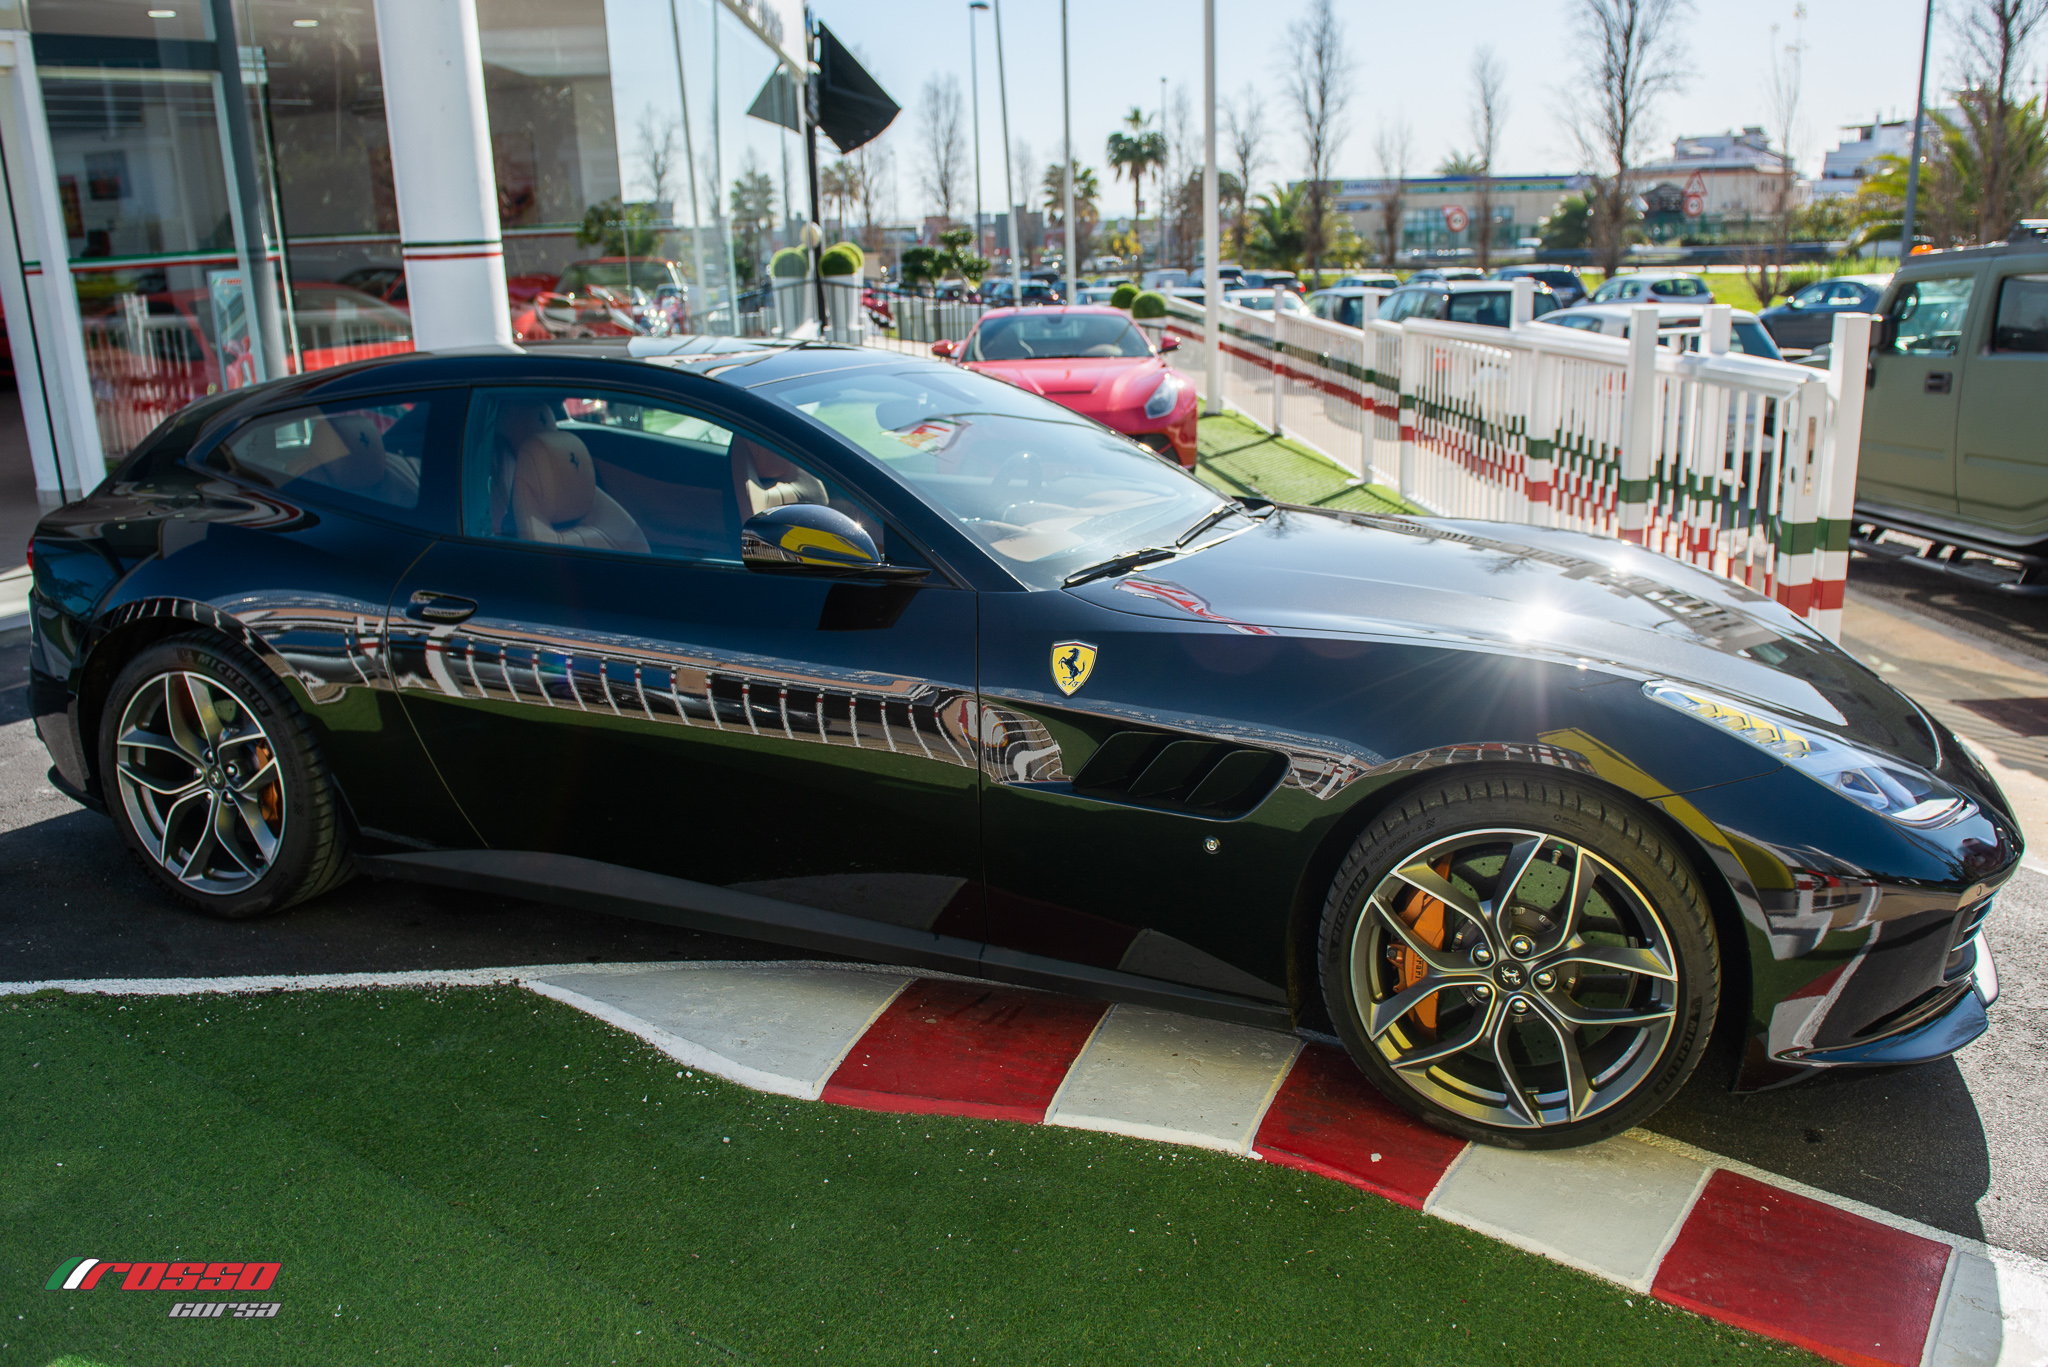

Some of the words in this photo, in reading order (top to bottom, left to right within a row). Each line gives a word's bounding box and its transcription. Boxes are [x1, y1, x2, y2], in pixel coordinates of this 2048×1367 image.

[197, 653, 268, 711] MICHELIN
[1061, 680, 1067, 688] S
[1369, 847, 1387, 866] PILOT
[1388, 830, 1411, 849] SPORT
[1333, 871, 1367, 943] MICHELIN
[1656, 1019, 1698, 1092] MICHELIN
